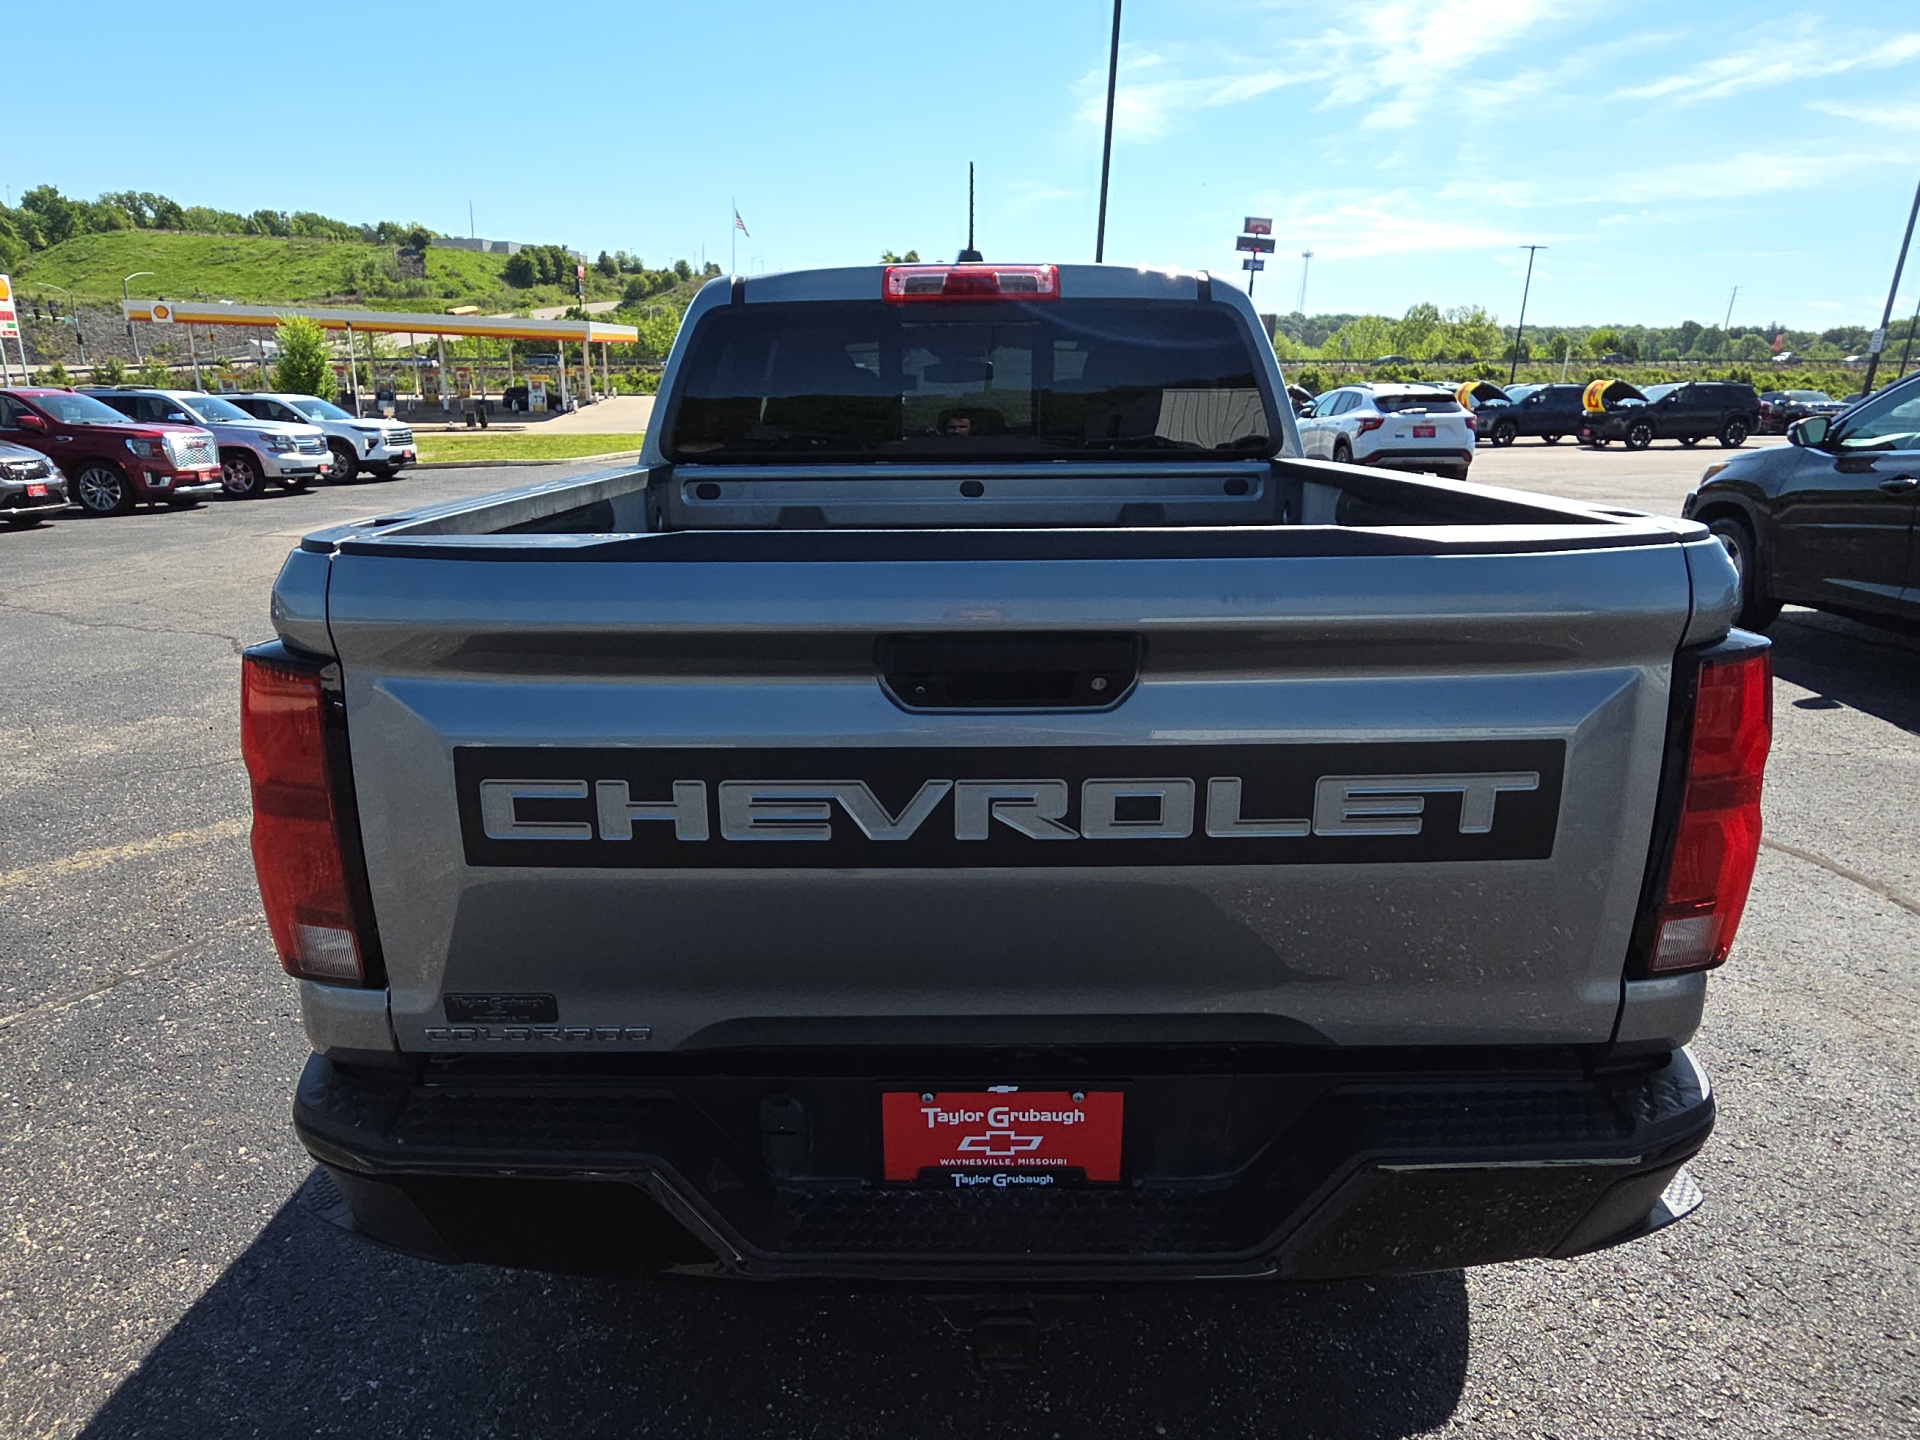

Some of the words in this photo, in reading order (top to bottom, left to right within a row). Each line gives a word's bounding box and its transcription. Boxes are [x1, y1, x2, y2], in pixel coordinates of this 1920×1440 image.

[480, 771, 1540, 842] CHEVROLET
[424, 1026, 653, 1042] COLORADO
[921, 1107, 984, 1128] Taylor
[987, 1106, 1085, 1127] Grubaugh
[939, 1158, 1015, 1166] WAYNESVILLE,
[1017, 1158, 1067, 1166] MISSOURI
[951, 1173, 991, 1187] Taylor
[992, 1173, 1054, 1187] Grubaugh
